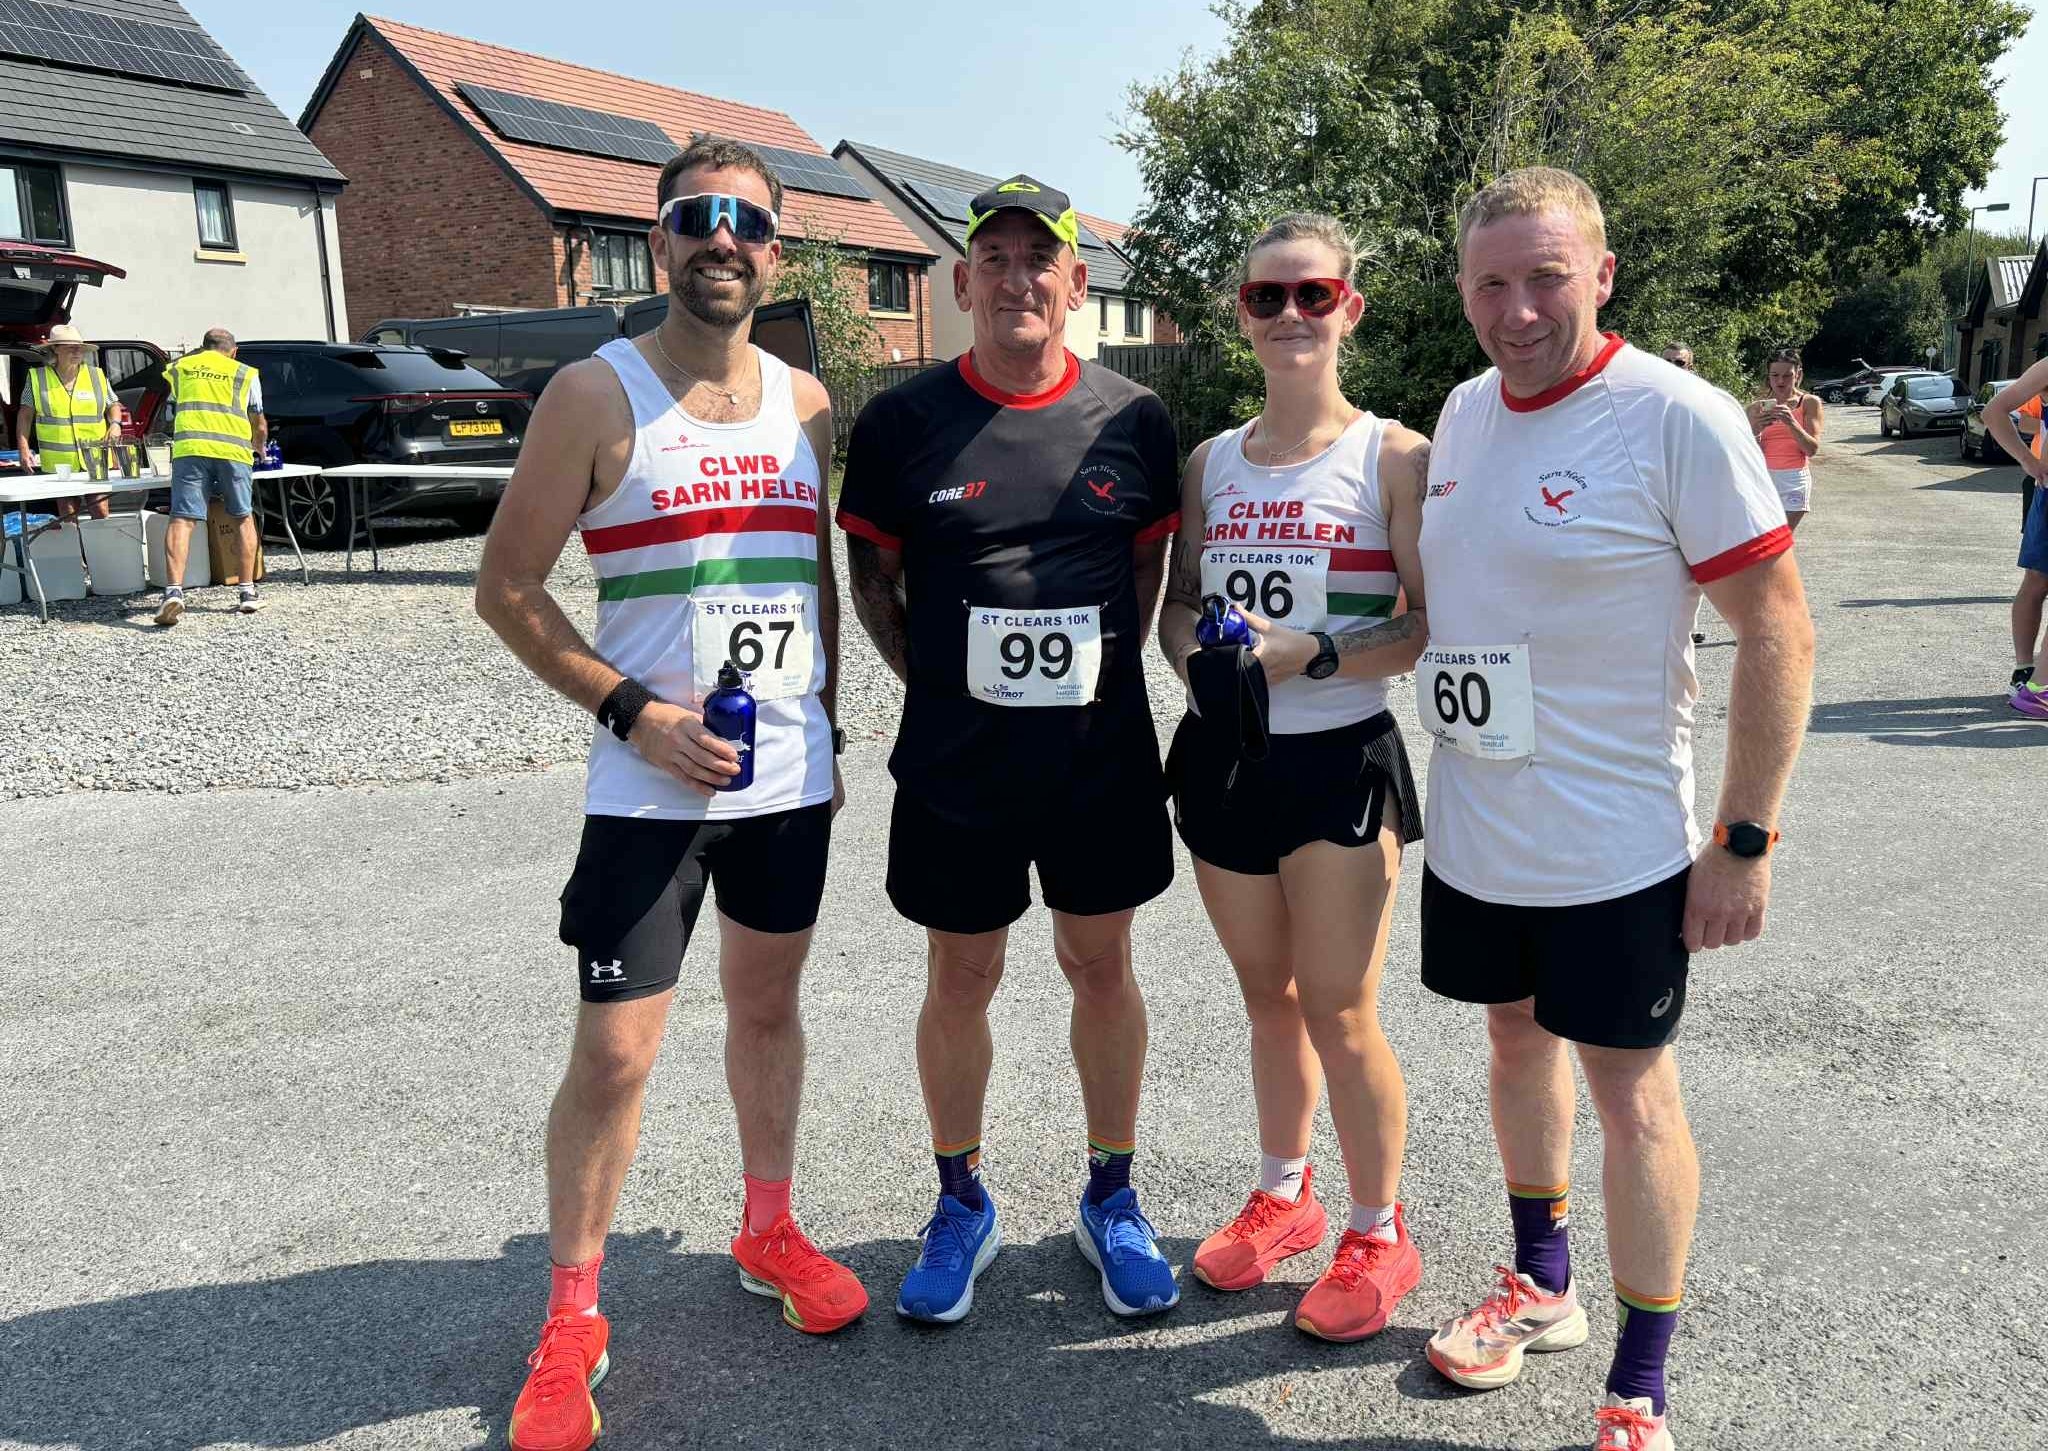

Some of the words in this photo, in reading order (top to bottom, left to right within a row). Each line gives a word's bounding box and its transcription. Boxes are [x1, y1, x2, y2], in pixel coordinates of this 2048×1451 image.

[700, 454, 780, 477] CLWB
[1538, 470, 1562, 484] Sarn
[1563, 469, 1589, 490] Helen
[651, 480, 731, 511] SARN
[741, 478, 817, 503] HELEN
[928, 480, 988, 504] CORE37
[1228, 501, 1304, 520] CLWB
[1204, 522, 1249, 541] ARN
[1257, 522, 1355, 543] HELEN
[1210, 553, 1226, 563] ST
[1229, 553, 1283, 564] CLEARS
[1288, 554, 1314, 566] 10K
[1226, 569, 1294, 619] 96
[706, 604, 726, 615] ST
[731, 603, 787, 615] CLEARS
[981, 614, 999, 625] ST
[1004, 616, 1062, 627] CLEARS
[1067, 613, 1090, 626] 10K
[729, 620, 795, 672] 67
[1000, 632, 1073, 680] 99
[1422, 652, 1434, 662] ST
[1434, 652, 1477, 665] CLEARS
[1481, 652, 1512, 665] 10K
[1434, 670, 1491, 727] 60
